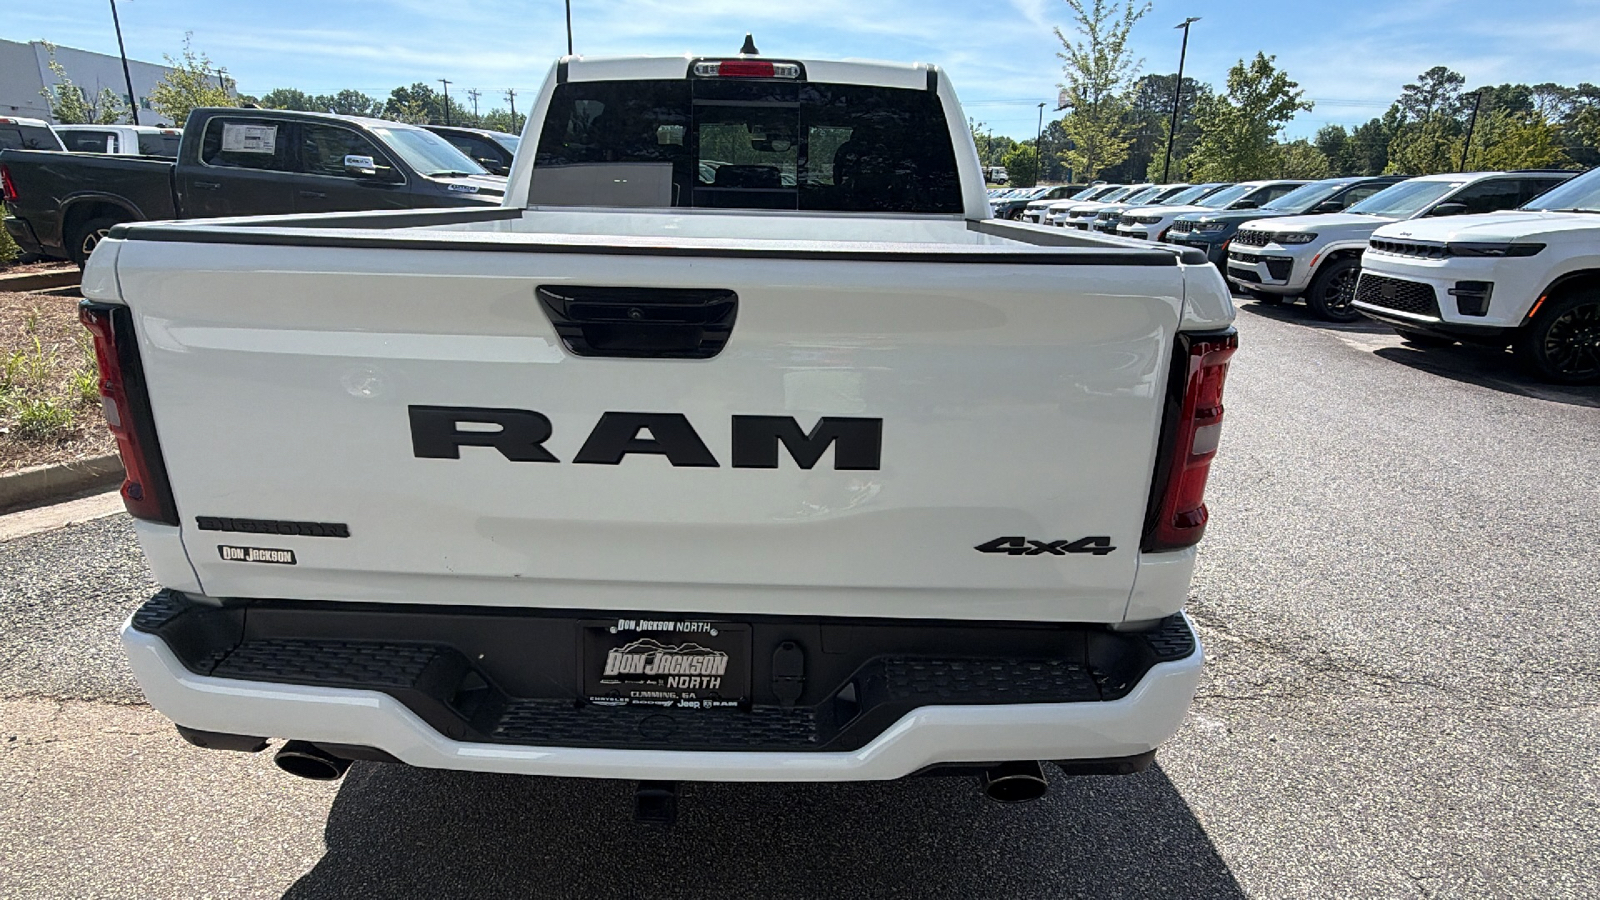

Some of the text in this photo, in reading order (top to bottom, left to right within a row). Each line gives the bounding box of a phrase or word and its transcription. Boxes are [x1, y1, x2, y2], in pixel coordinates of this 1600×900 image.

[408, 404, 883, 471] RAM
[974, 536, 1117, 557] 4x4
[676, 622, 711, 632] NORTH
[603, 652, 729, 675] DON JACKSON
[667, 676, 721, 689] NORTH
[677, 699, 700, 708] Jeep
